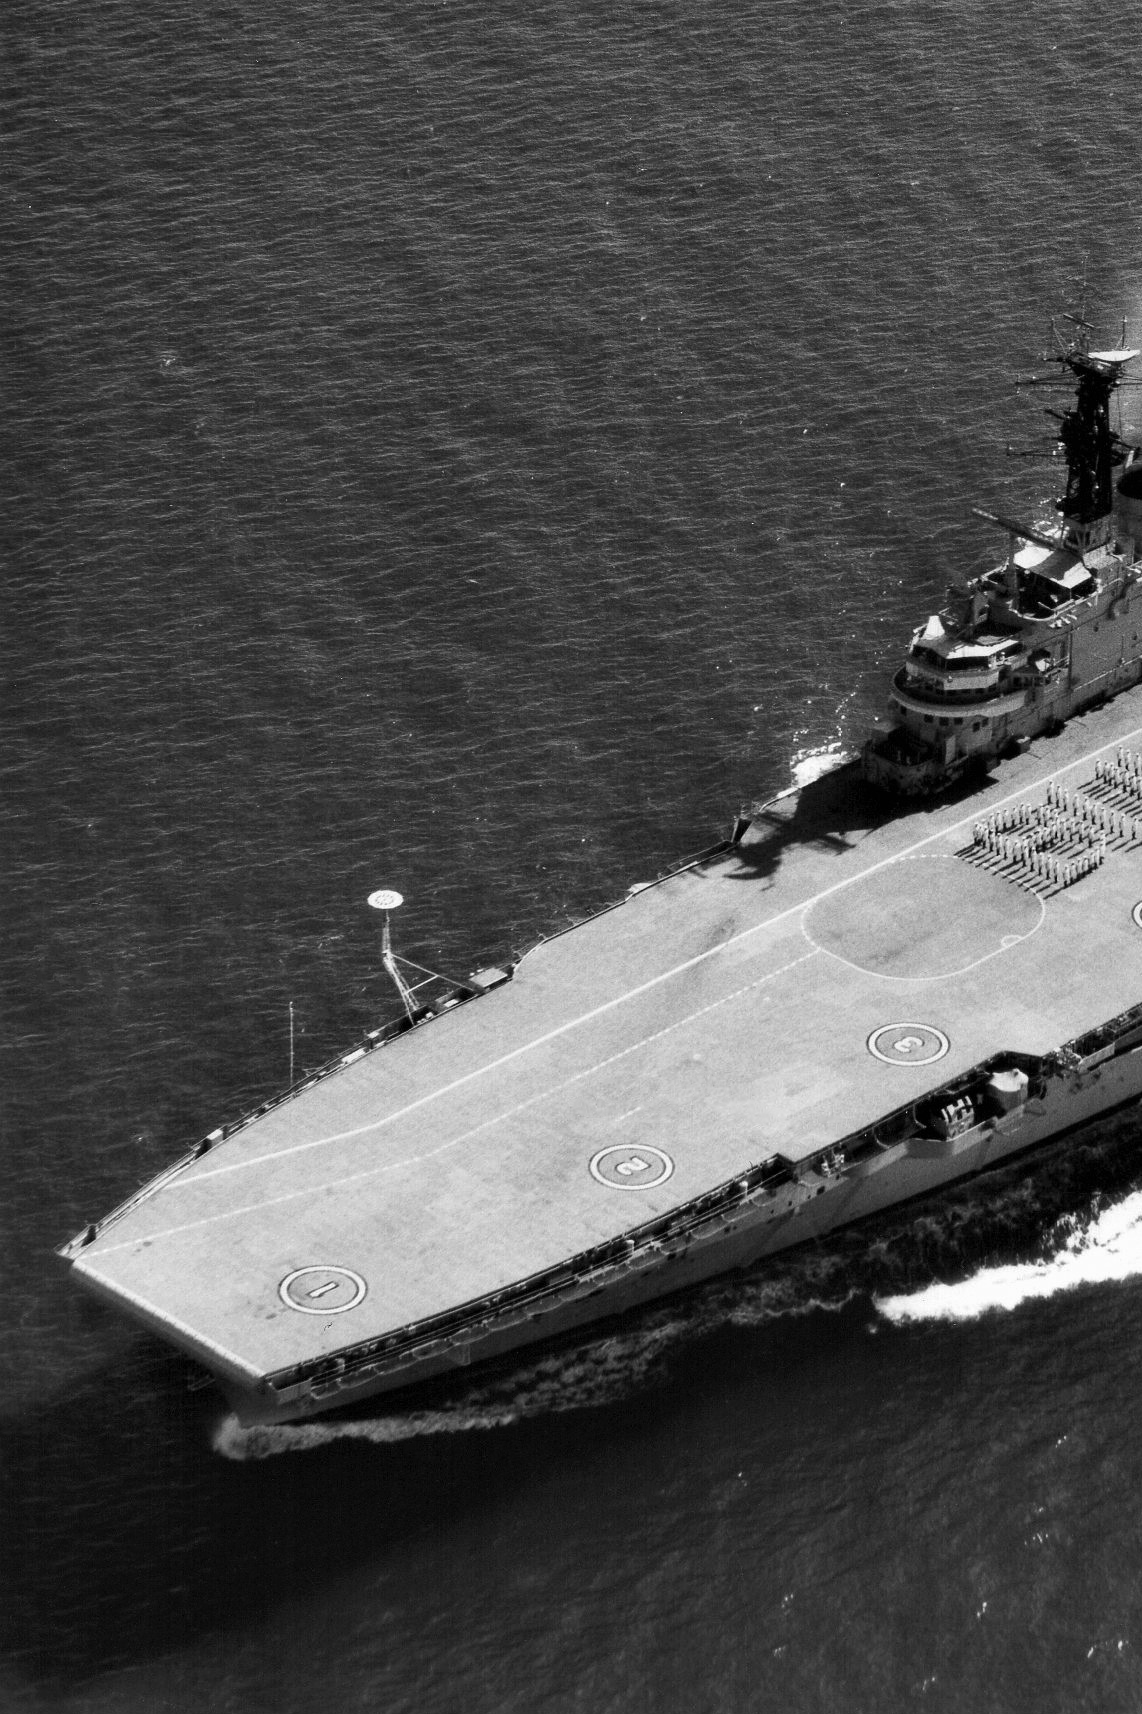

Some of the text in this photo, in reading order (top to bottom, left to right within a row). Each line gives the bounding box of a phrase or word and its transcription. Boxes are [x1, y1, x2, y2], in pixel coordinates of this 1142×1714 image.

[892, 1035, 925, 1053] 3
[615, 1155, 653, 1176] 2
[306, 1280, 340, 1299] 1
